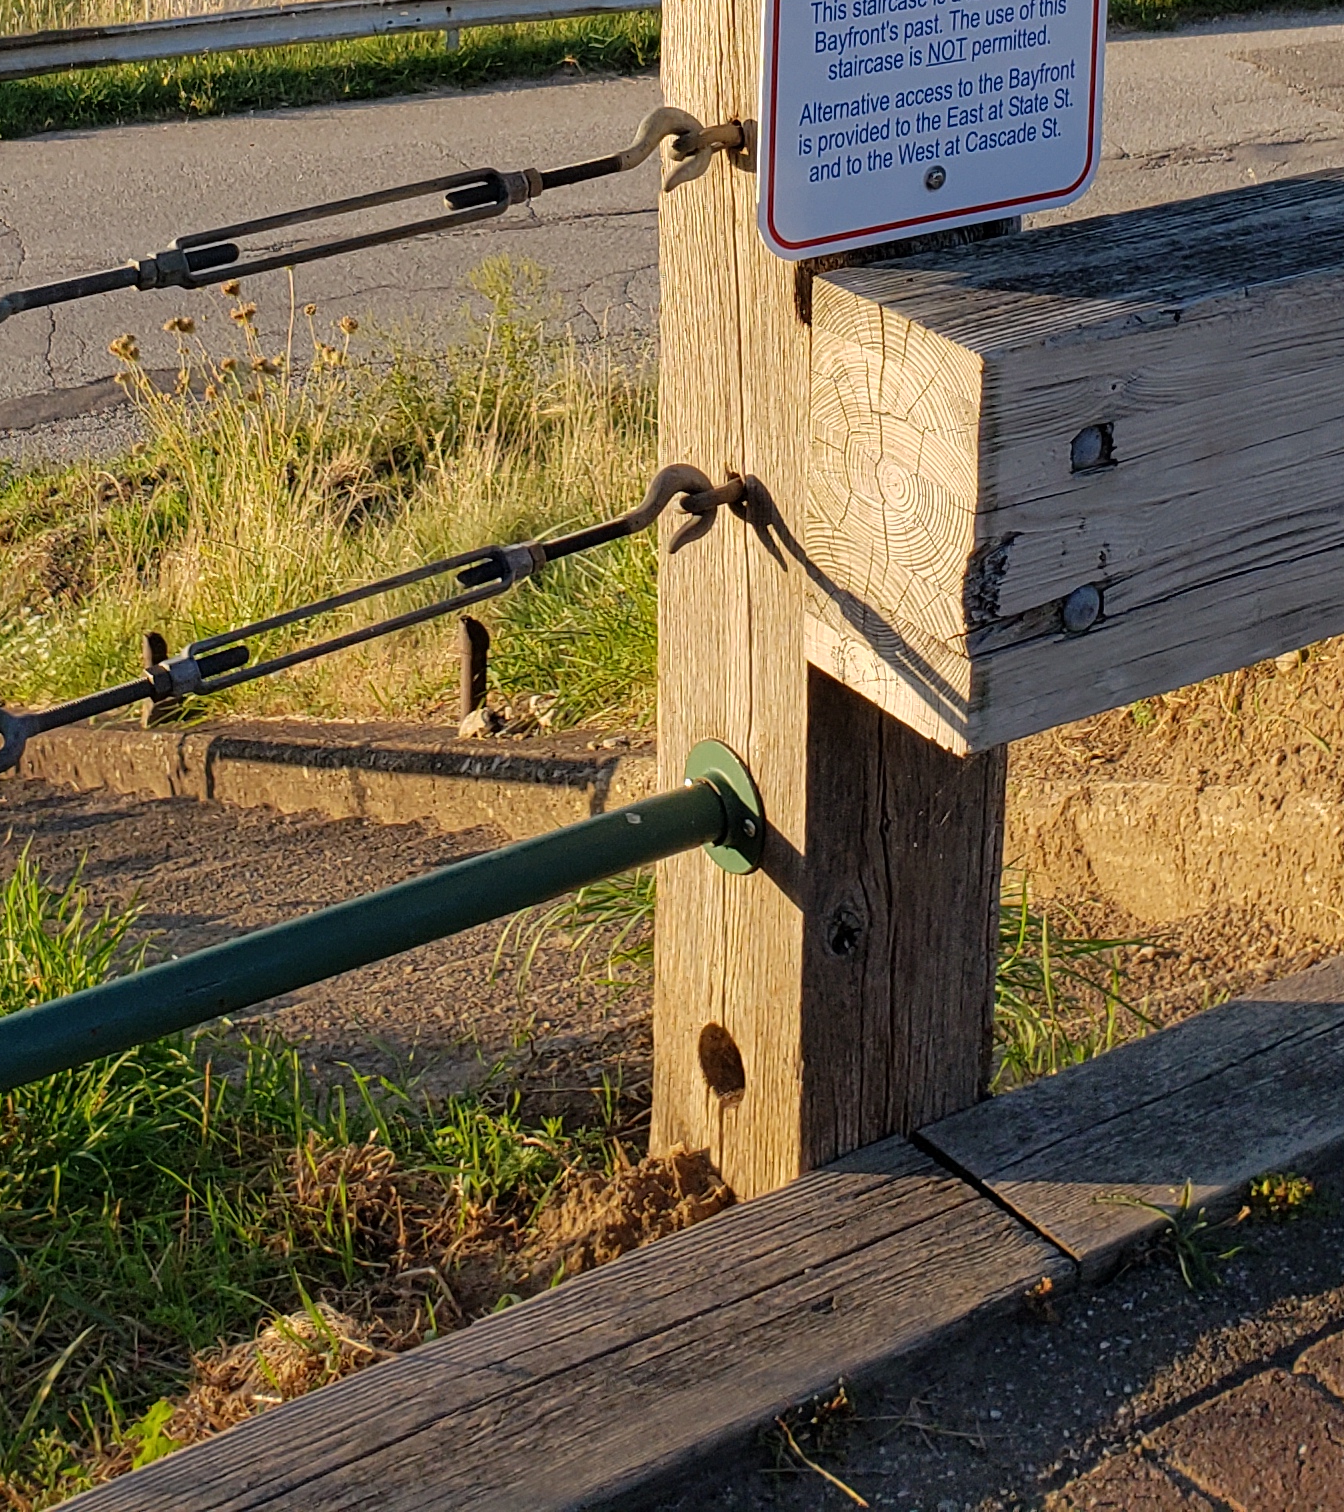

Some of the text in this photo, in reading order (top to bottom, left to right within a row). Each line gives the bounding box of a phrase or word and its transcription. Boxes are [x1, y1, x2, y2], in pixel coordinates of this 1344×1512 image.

[811, 0, 847, 24] This
[815, 20, 898, 59] Bayfront's
[904, 13, 943, 45] past.
[949, 9, 980, 31] The
[986, 7, 1014, 26] use
[828, 24, 1050, 80] staircase is NOT permitted.
[799, 59, 1075, 128] Alternative access to the Bayfront
[799, 88, 1073, 158] is provided to the East at State St.
[809, 117, 1061, 182] and to the West at Cascade St.
